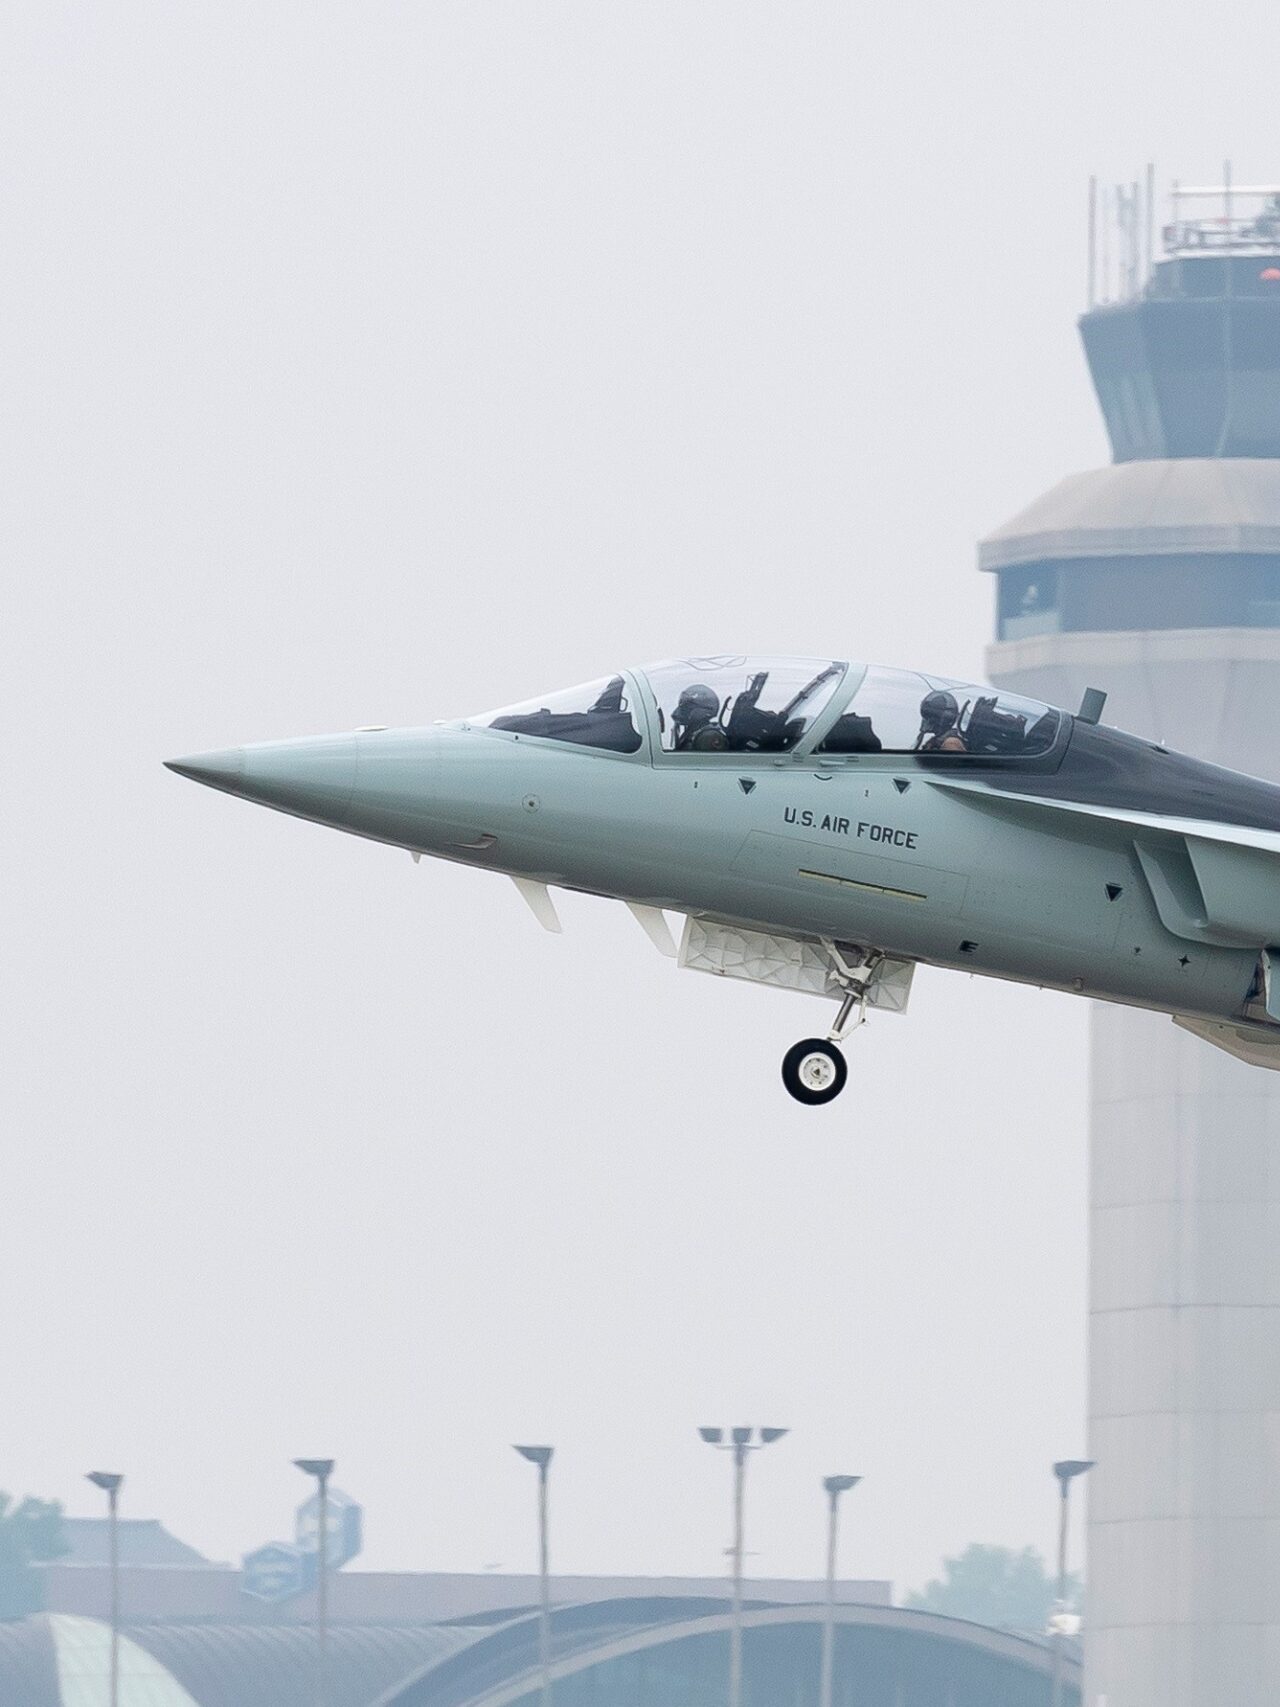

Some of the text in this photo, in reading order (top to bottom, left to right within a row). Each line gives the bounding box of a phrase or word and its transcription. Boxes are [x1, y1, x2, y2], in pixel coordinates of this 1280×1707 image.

[784, 807, 919, 849] U.S. AIR FORCE
